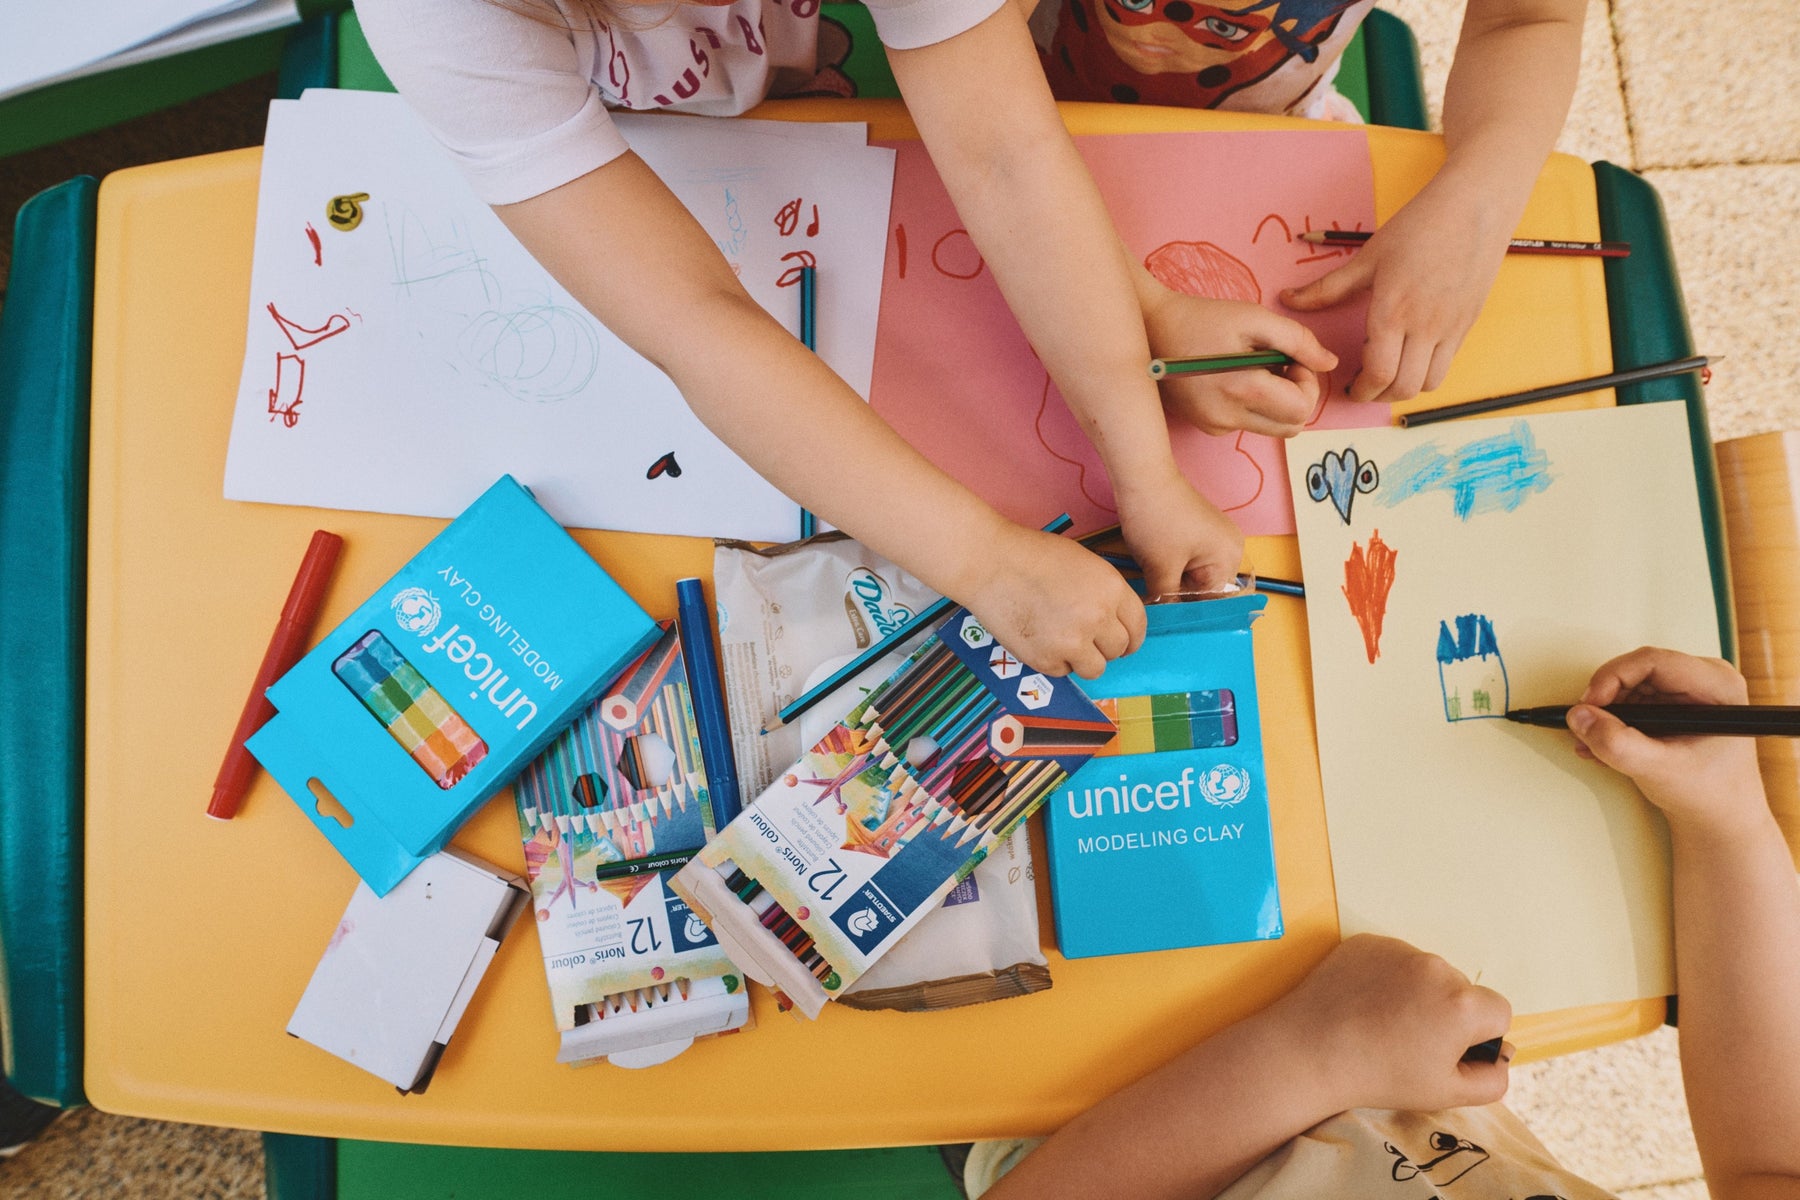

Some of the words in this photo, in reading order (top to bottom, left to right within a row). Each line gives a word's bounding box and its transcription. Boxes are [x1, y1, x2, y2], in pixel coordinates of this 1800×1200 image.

[437, 566, 481, 607] CLAY
[479, 604, 563, 691] MODELING
[422, 624, 538, 731] unicef
[1067, 767, 1194, 819] unicef
[750, 813, 779, 844] colour
[1077, 828, 1188, 854] MODELING
[1193, 823, 1244, 842] CLAY
[648, 859, 669, 869] colour
[670, 857, 689, 865] Noris
[808, 858, 848, 900] 12
[862, 889, 896, 923] STAEDTLER
[626, 916, 662, 955] 12
[551, 954, 586, 969] colour
